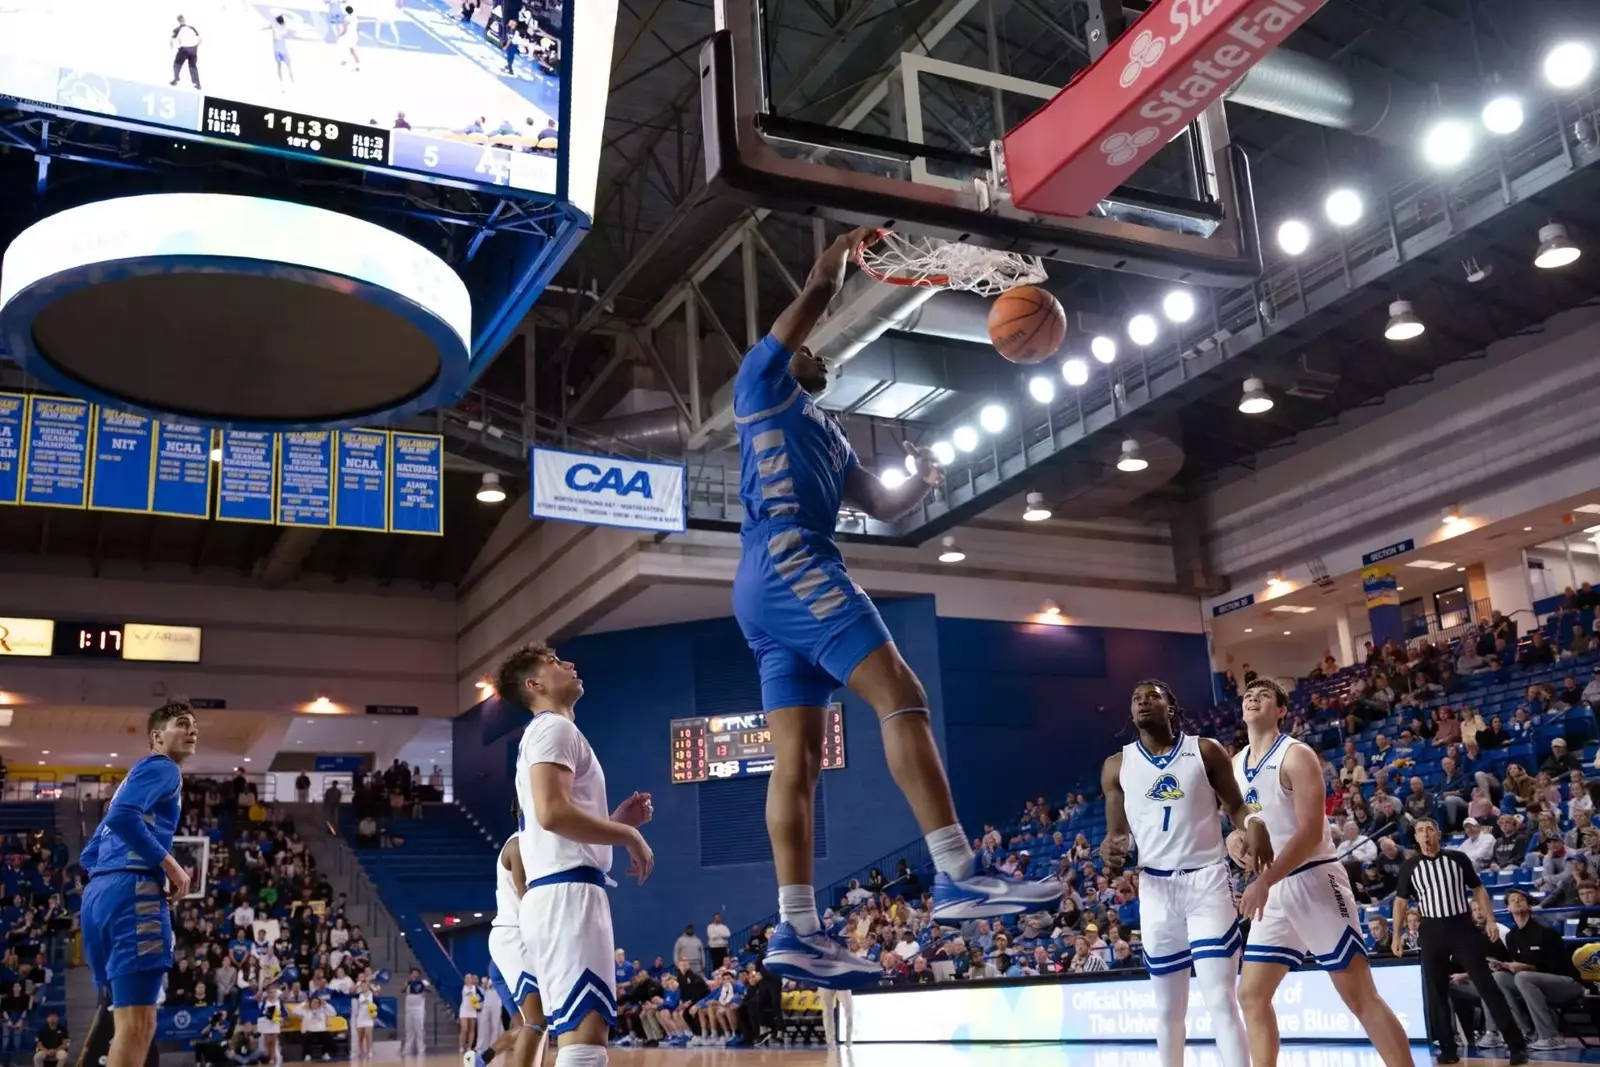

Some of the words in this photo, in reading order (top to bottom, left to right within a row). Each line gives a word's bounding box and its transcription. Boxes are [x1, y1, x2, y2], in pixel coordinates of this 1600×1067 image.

[1139, 43, 1250, 125] State
[142, 92, 176, 120] 13
[207, 119, 241, 136] TOL:4
[263, 113, 339, 140] 11:39
[352, 145, 383, 161] TOL:4
[423, 145, 440, 168] 5
[40, 426, 80, 437] REGULAR
[32, 440, 84, 452] CHAMPIONS
[112, 438, 137, 451] NIT
[166, 441, 202, 454] NCAA
[345, 457, 379, 470] NCAA
[396, 463, 438, 475] NATIONAL
[564, 463, 654, 500] CAA
[553, 495, 574, 503] NORTH
[574, 498, 604, 507] CAROLINA
[536, 502, 557, 510] STONY
[634, 514, 657, 522] WILLIAM
[1369, 545, 1397, 562] SECTION
[1218, 600, 1241, 614] SECTION
[79, 629, 121, 651] 1:17
[834, 713, 840, 723] 3
[834, 724, 841, 733] 0
[743, 730, 771, 744] 11:39
[834, 735, 841, 744] 0
[716, 745, 727, 756] 13
[835, 746, 841, 755] 2
[822, 757, 829, 767] 0
[1162, 805, 1172, 832] 1
[1071, 989, 1121, 1011] Official
[1284, 980, 1303, 1004] of
[1089, 1013, 1115, 1033] The
[1195, 1011, 1213, 1033] of
[1303, 1007, 1349, 1032] Blue
